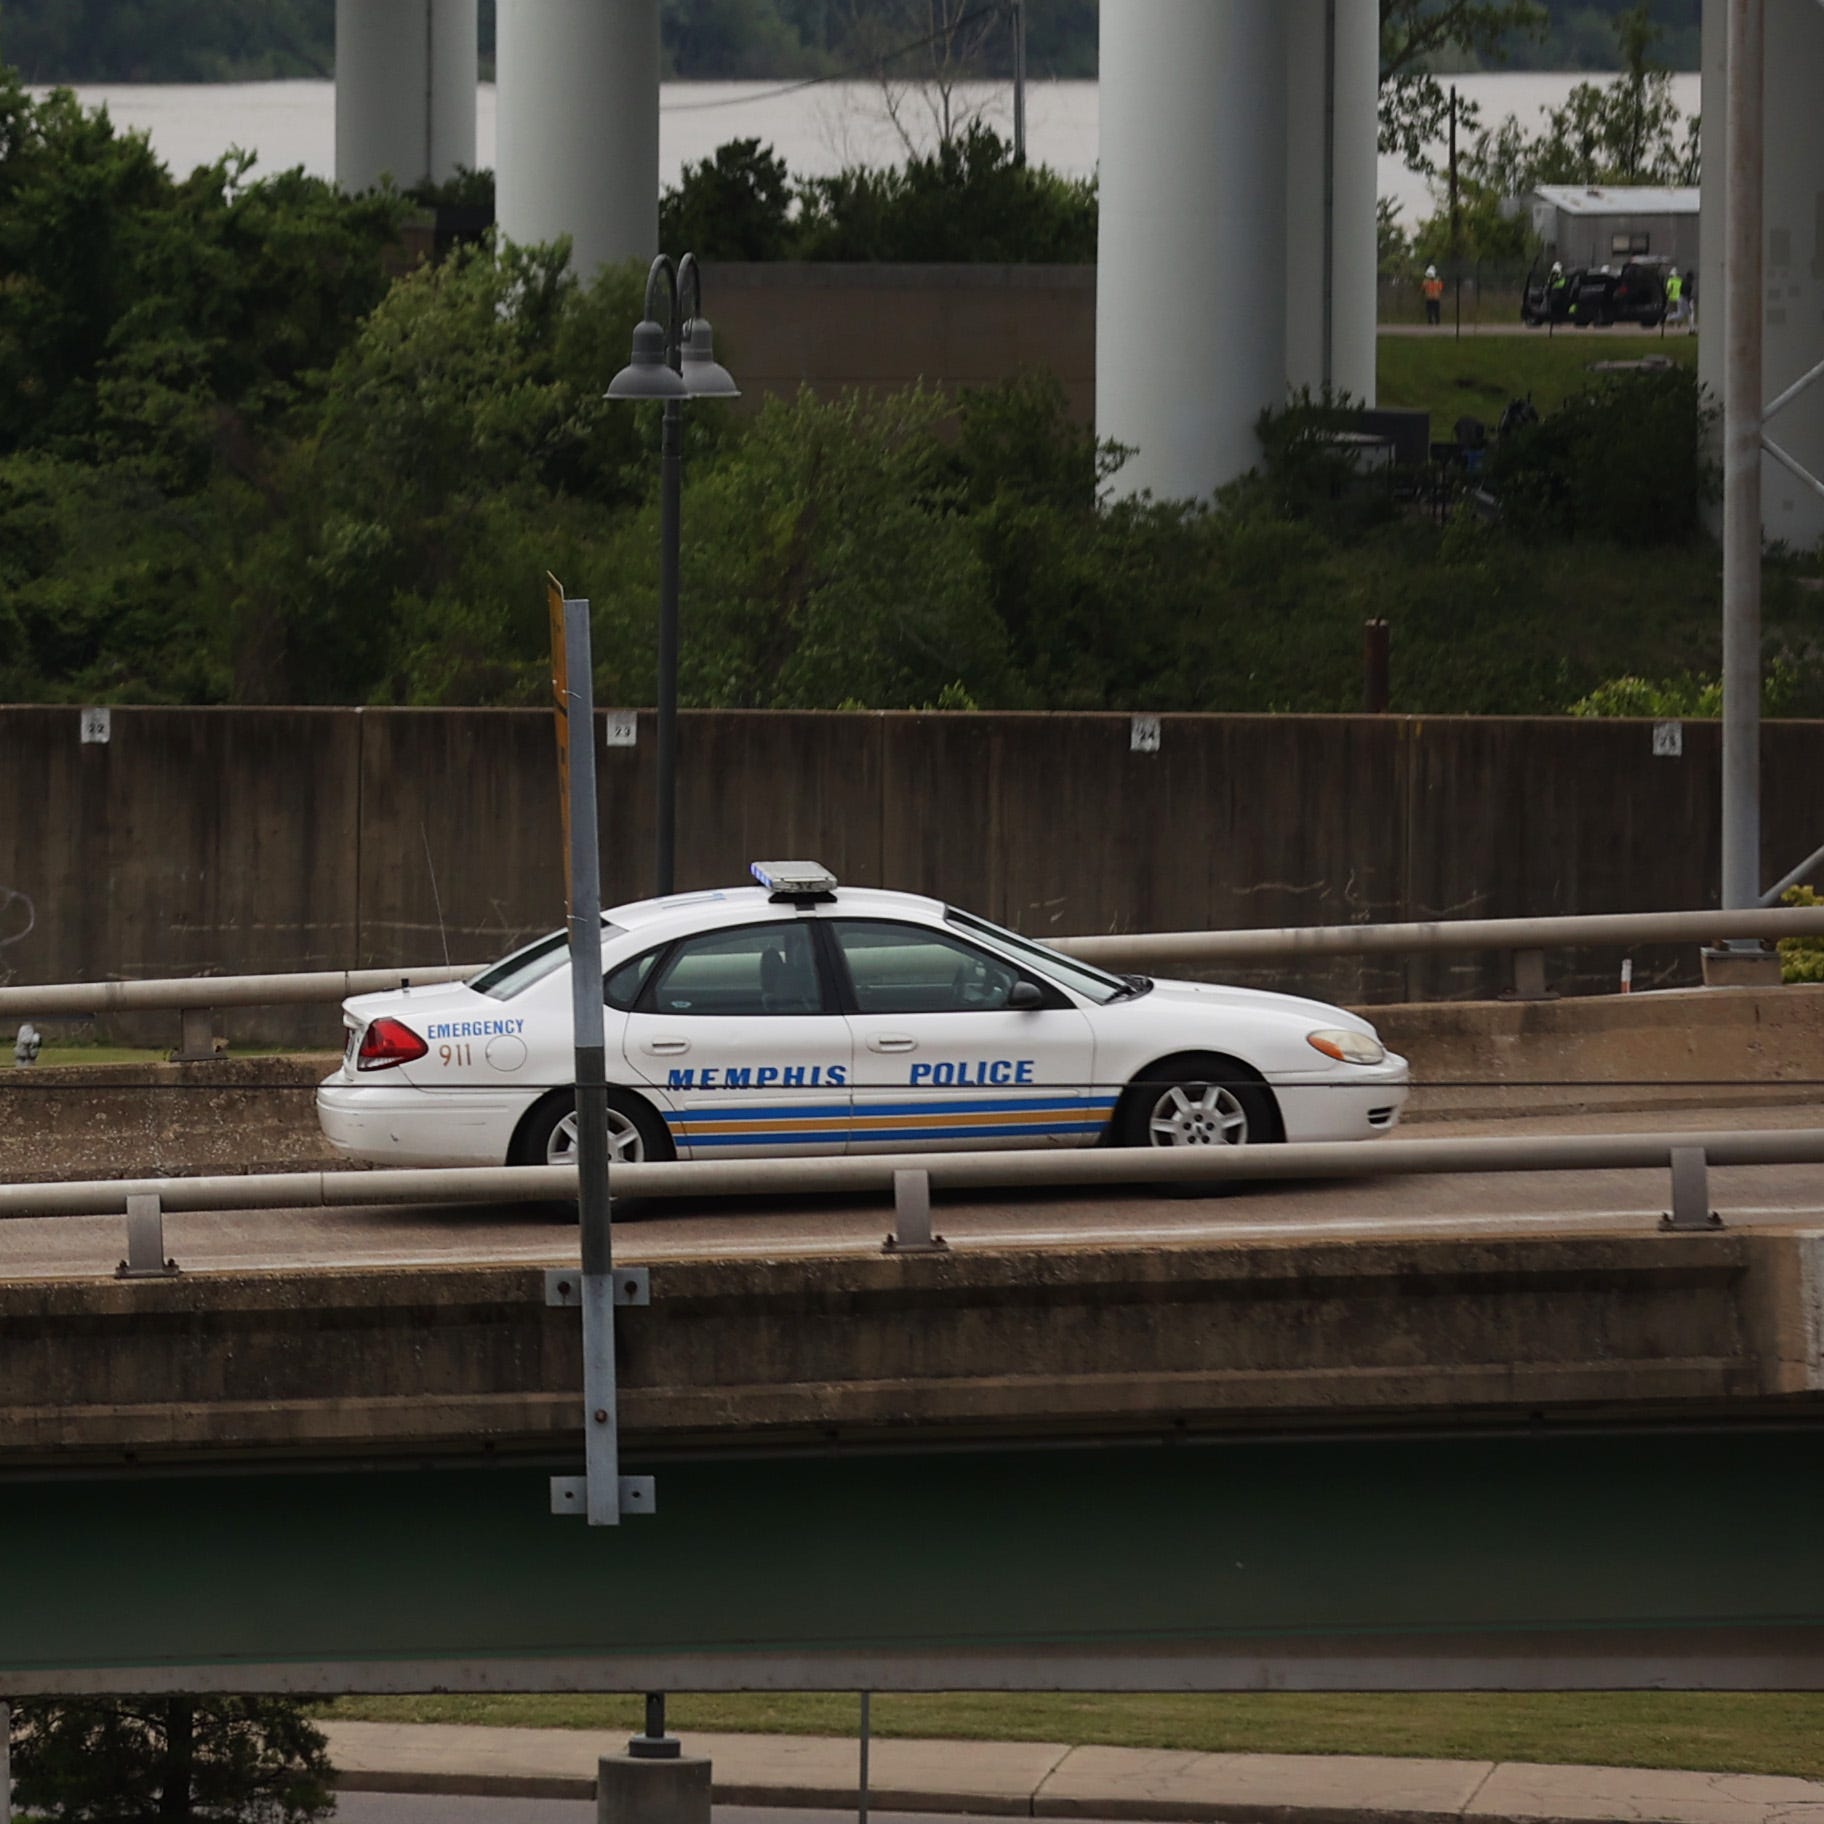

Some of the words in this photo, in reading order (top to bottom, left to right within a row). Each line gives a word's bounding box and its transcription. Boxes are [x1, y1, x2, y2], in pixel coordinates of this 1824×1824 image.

[88, 722, 105, 734] 22
[427, 1019, 524, 1039] EMERGENCY
[439, 1043, 471, 1067] 911
[667, 1065, 847, 1090] MEMPHIS
[909, 1060, 1035, 1086] POLICE
